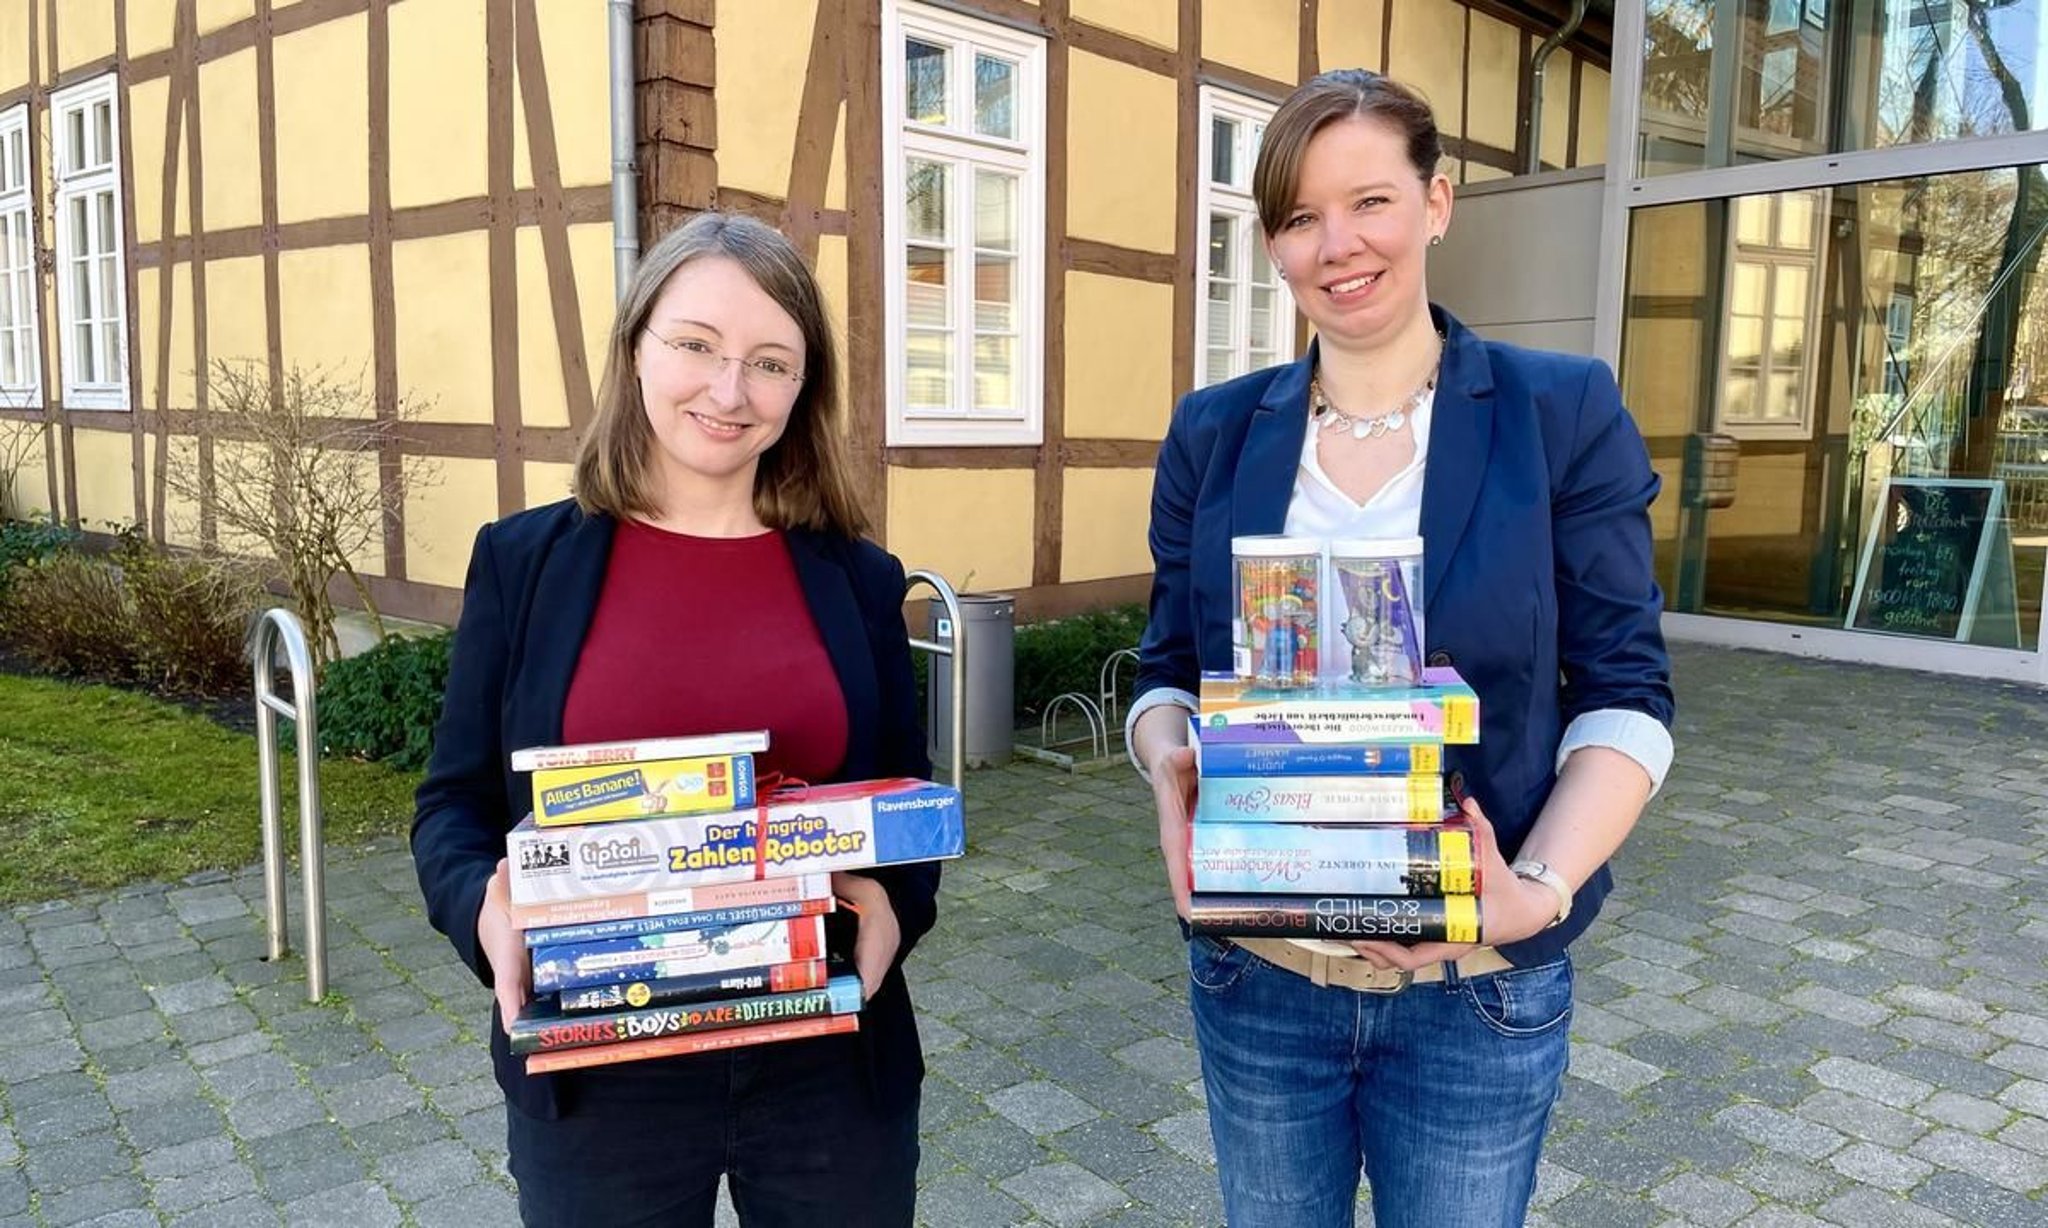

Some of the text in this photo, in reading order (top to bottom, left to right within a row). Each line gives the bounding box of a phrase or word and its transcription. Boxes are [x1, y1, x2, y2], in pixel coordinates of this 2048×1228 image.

[545, 785, 582, 807] Alles
[583, 769, 640, 799] Banane!
[1225, 786, 1312, 815] Elsas Erbe
[877, 795, 956, 813] Ravensburger
[707, 815, 825, 842] Der hngrige
[580, 840, 641, 868] tiptoi
[669, 830, 866, 871] Zahlen Roboter
[1318, 861, 1372, 870] LORENTZ
[1316, 915, 1421, 934] PRESTON
[538, 1020, 617, 1047] STORIES
[627, 1011, 681, 1037] BOYS
[743, 994, 828, 1020] DIFFERENT
